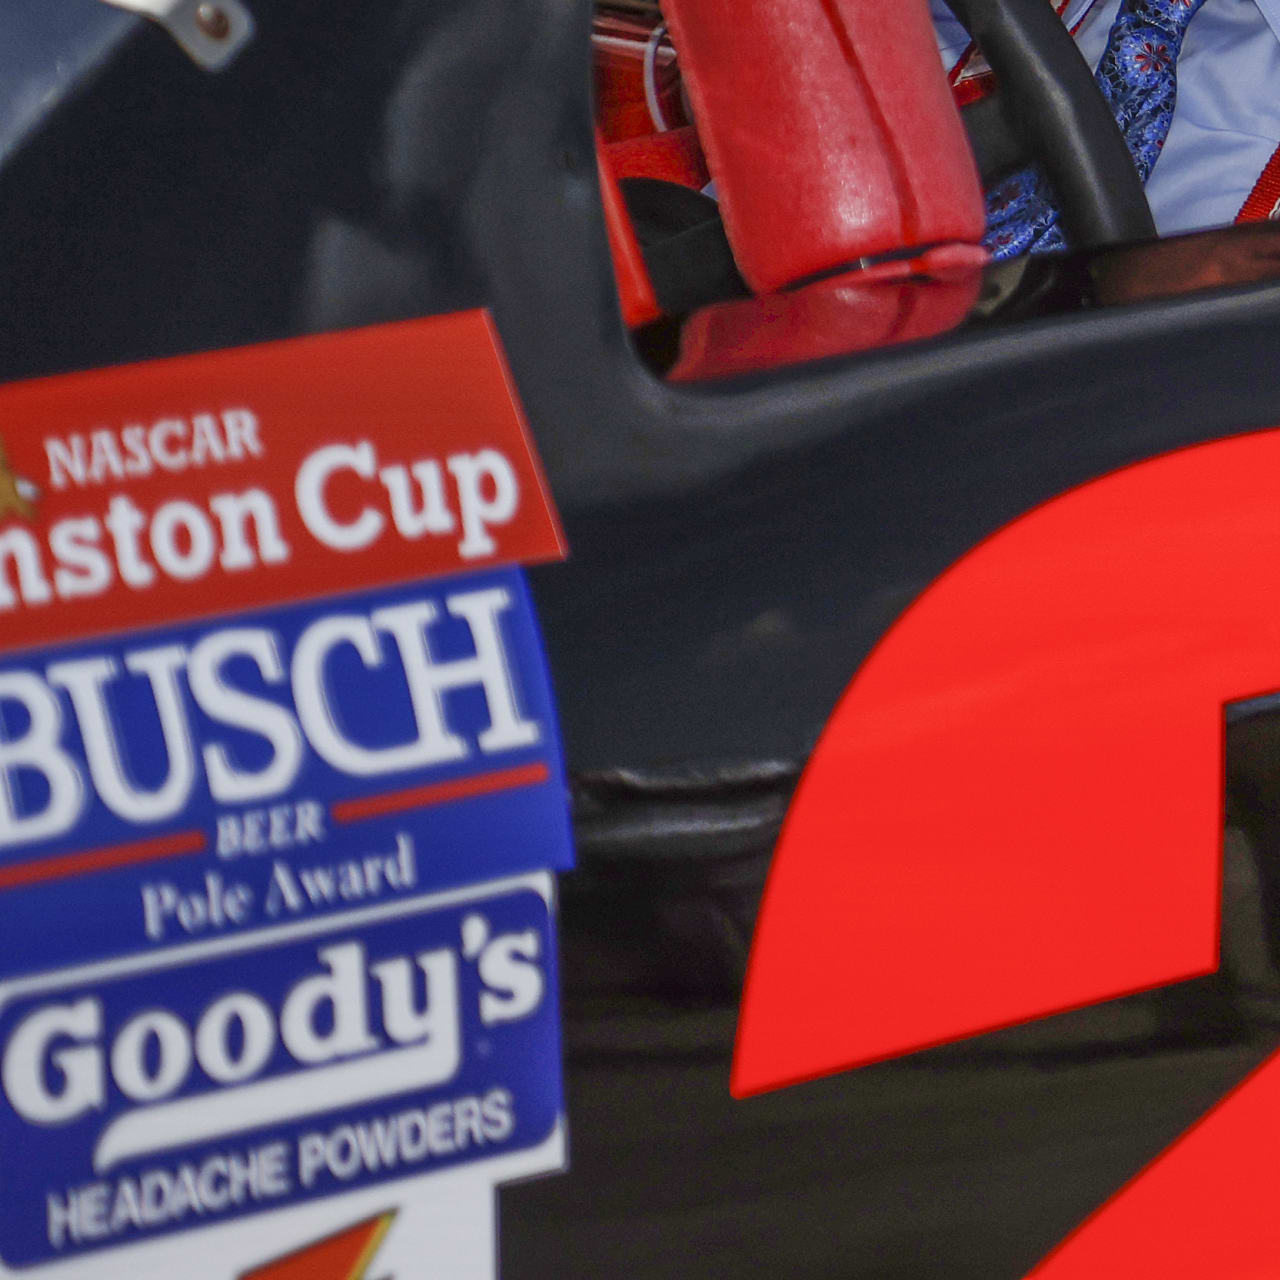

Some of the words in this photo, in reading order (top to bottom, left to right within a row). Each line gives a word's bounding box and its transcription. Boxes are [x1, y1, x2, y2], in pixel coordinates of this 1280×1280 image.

[44, 407, 263, 489] NASCAR
[294, 438, 520, 560] Cup
[0, 587, 541, 847] BUSCH
[141, 871, 253, 940] Pole
[265, 832, 417, 915] Award
[215, 801, 326, 859] BEER
[1, 914, 545, 1135] Goody's
[47, 1139, 289, 1249] HEADACHE
[299, 1087, 515, 1187] POWDERS
